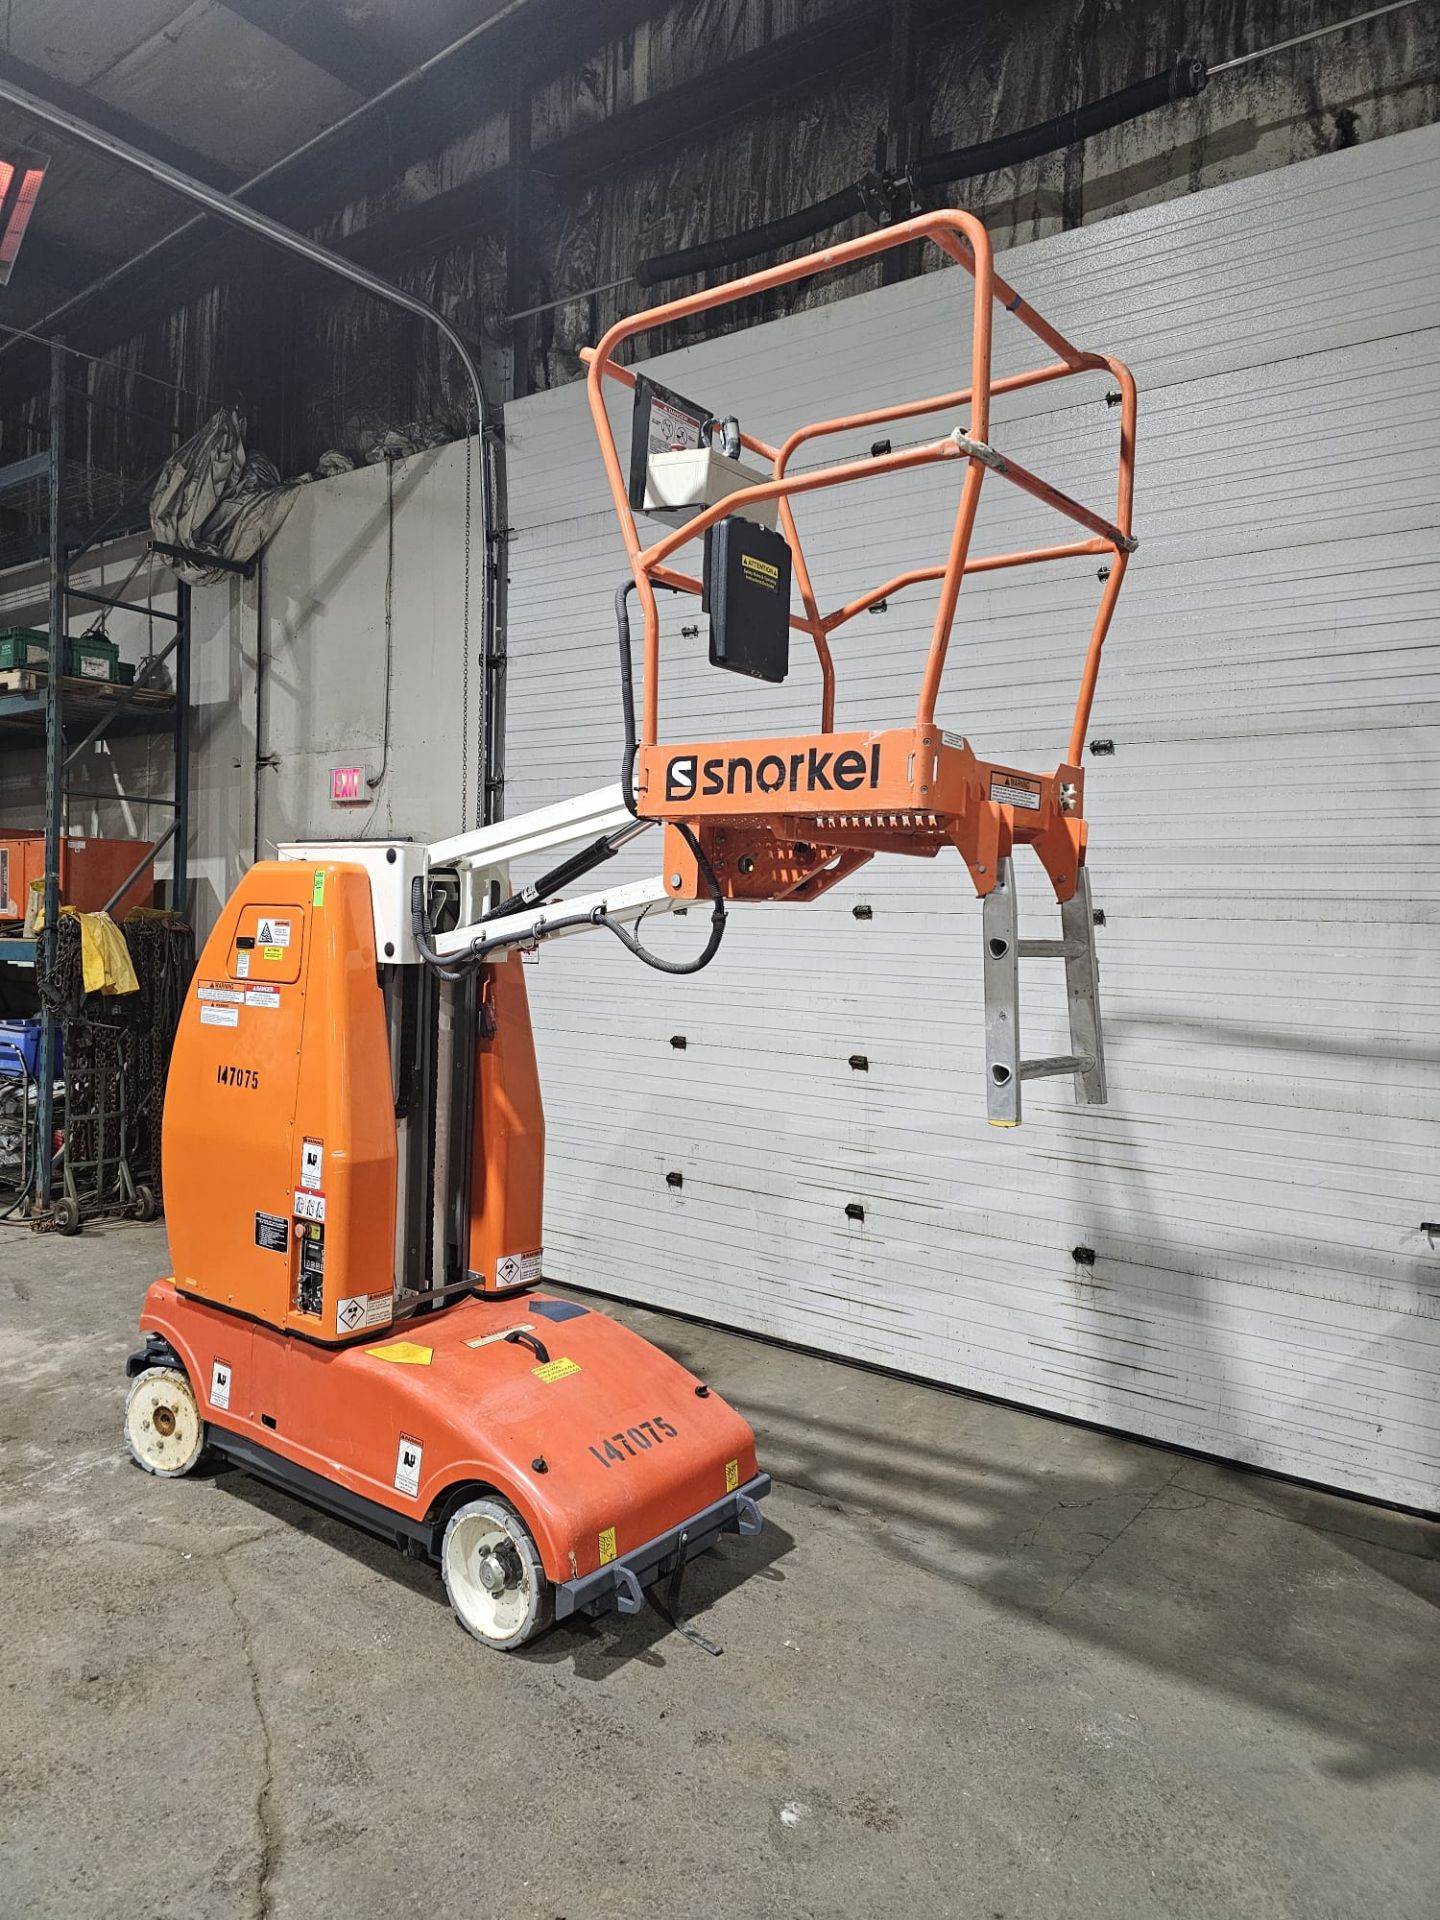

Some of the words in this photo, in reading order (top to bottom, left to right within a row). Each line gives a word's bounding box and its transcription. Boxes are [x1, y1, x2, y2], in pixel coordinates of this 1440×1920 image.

[748, 559, 774, 575] ATTENTION
[702, 744, 880, 795] snorkel
[334, 768, 361, 798] EXIT
[1011, 777, 1030, 790] WARNING
[215, 982, 234, 990] WARNING
[255, 985, 274, 993] DANGER
[217, 1065, 258, 1090] 147075
[588, 1416, 678, 1468] 147075
